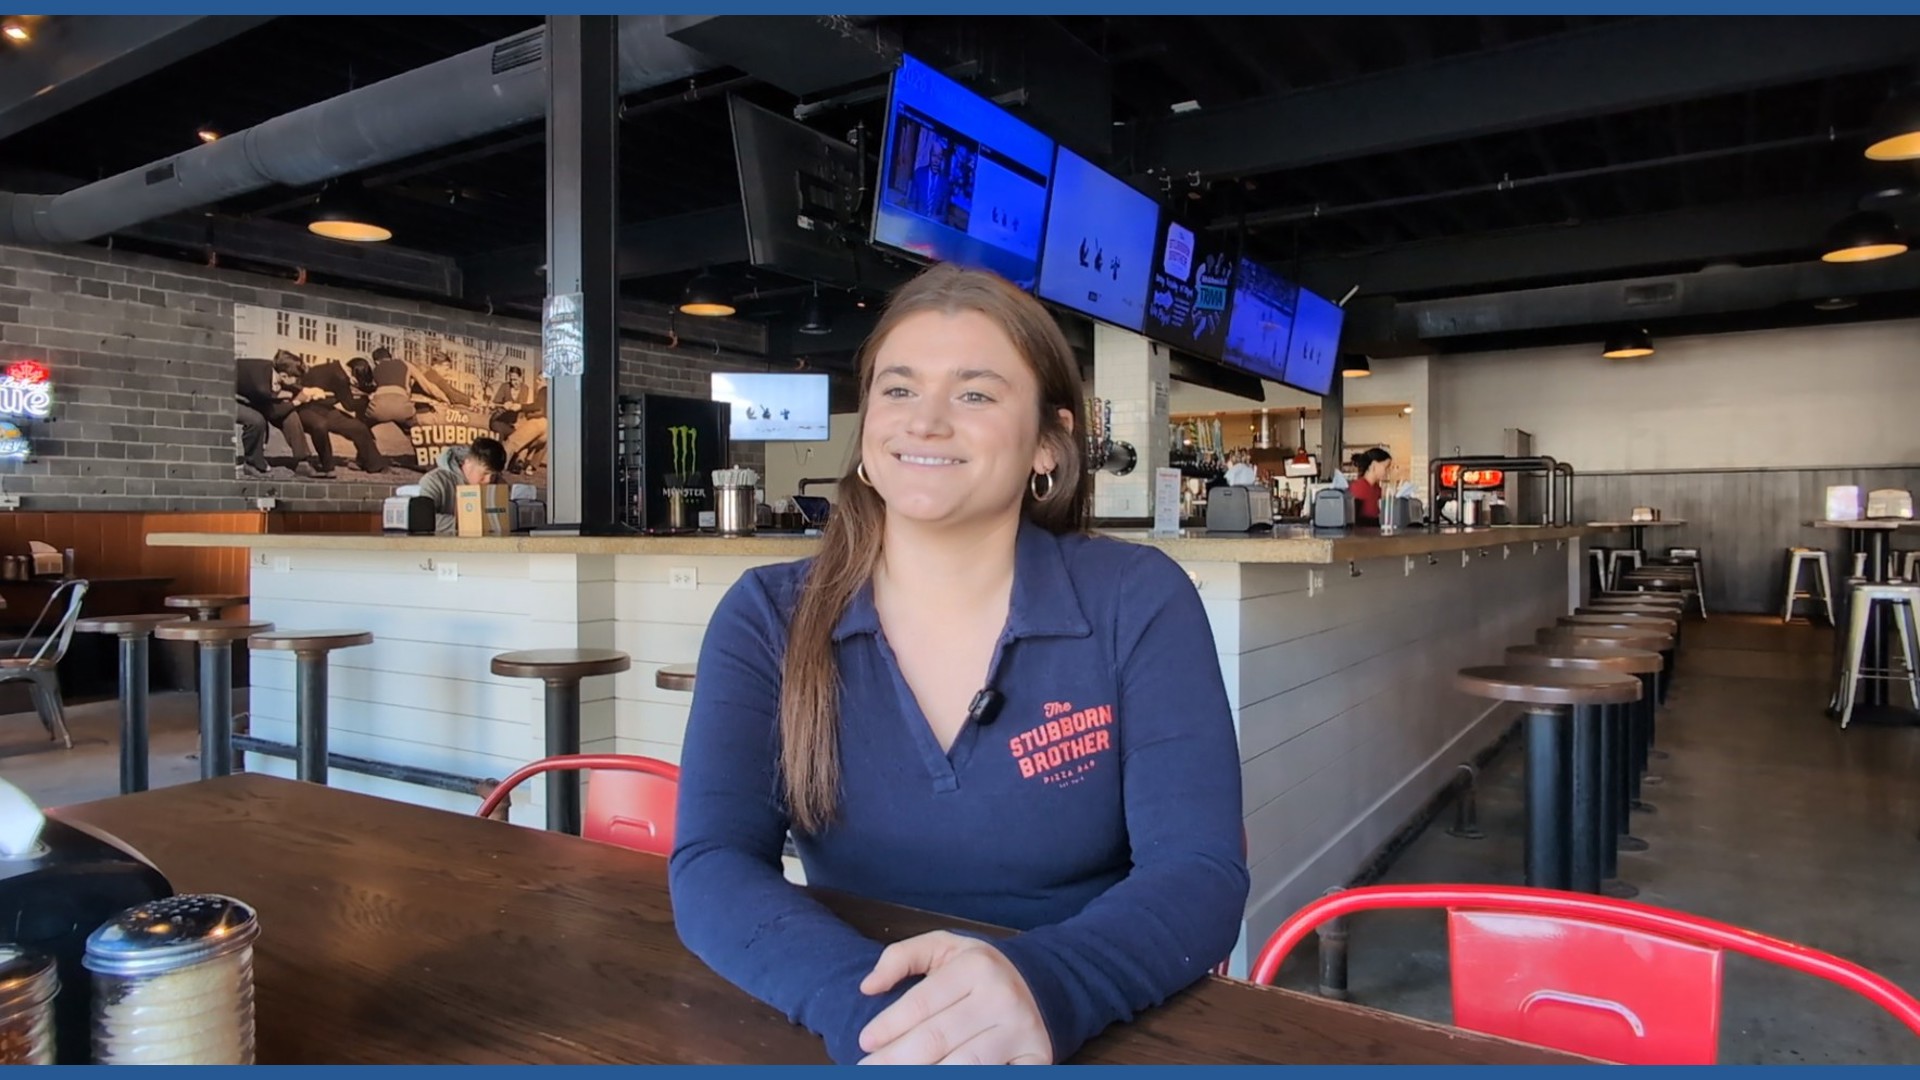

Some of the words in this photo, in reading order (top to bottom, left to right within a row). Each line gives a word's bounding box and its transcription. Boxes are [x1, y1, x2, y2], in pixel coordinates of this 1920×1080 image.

[1200, 287, 1225, 305] TRIVIA
[446, 409, 469, 423] The
[662, 486, 706, 498] MONSTER
[1043, 702, 1072, 718] The
[1010, 705, 1112, 757] STUBBORN
[1018, 730, 1109, 778] BROTHER
[1043, 770, 1073, 784] PIZZA
[1077, 760, 1095, 773] BAR
